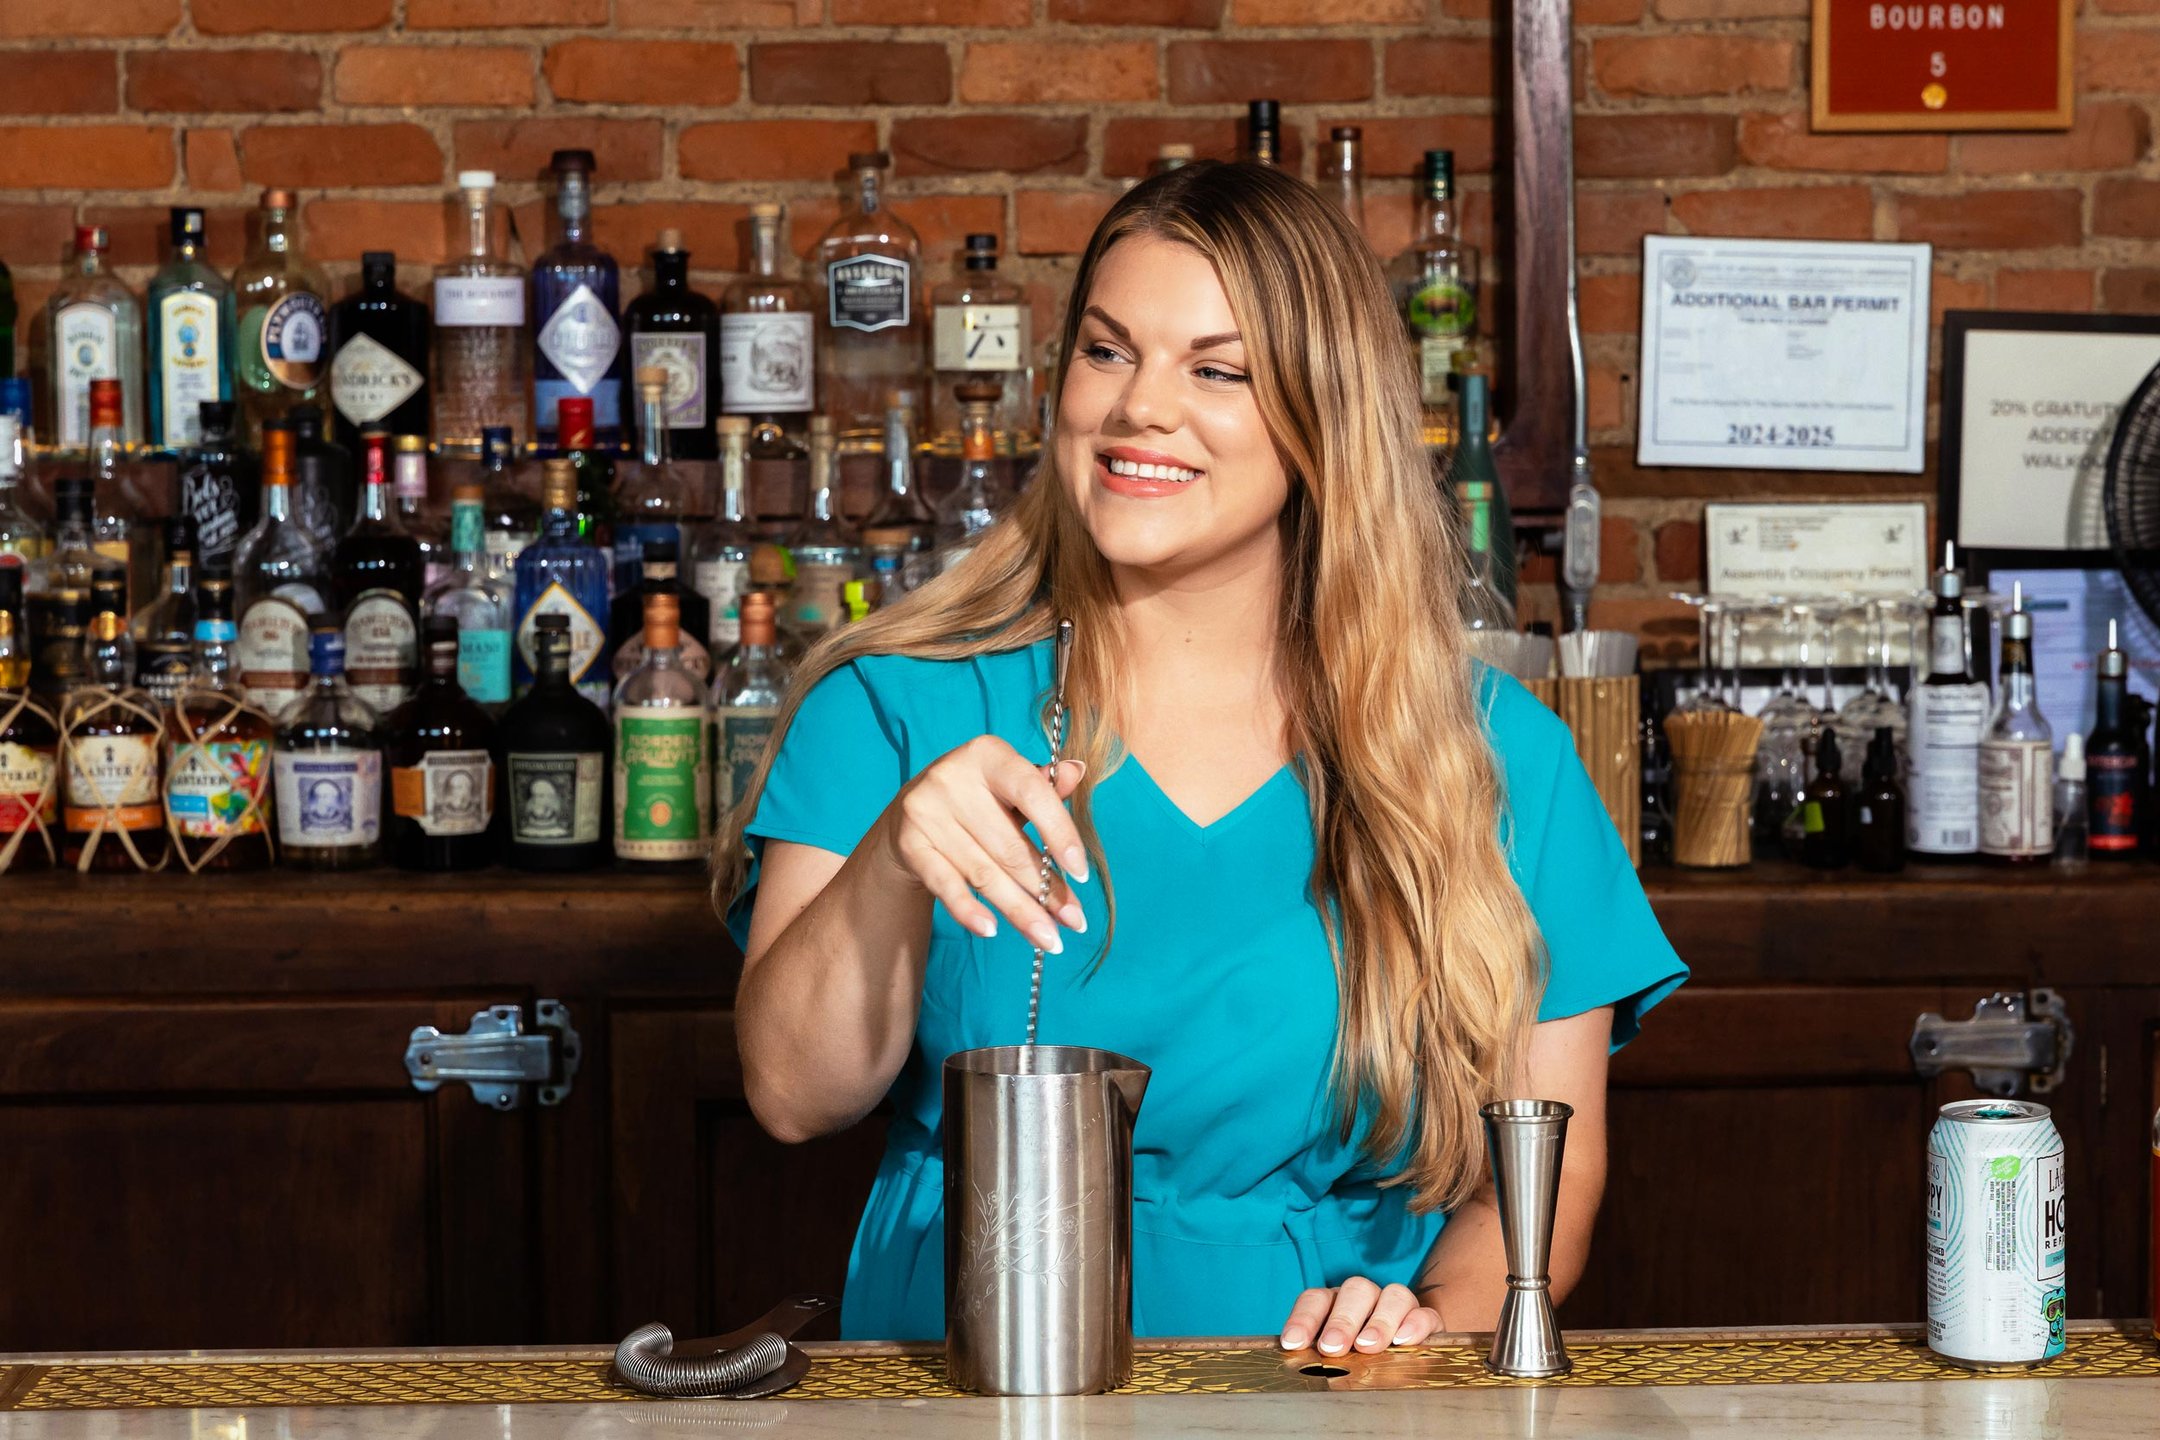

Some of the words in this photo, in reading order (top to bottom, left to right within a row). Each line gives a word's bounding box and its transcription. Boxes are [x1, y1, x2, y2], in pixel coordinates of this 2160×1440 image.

[1869, 3, 2005, 30] BOURBON
[1930, 51, 1947, 77] 5
[1671, 293, 1780, 309] ADDITIONAL
[1787, 295, 1827, 310] BAR
[1832, 296, 1901, 312] PERMIT
[1727, 422, 1835, 447] 2024-2025
